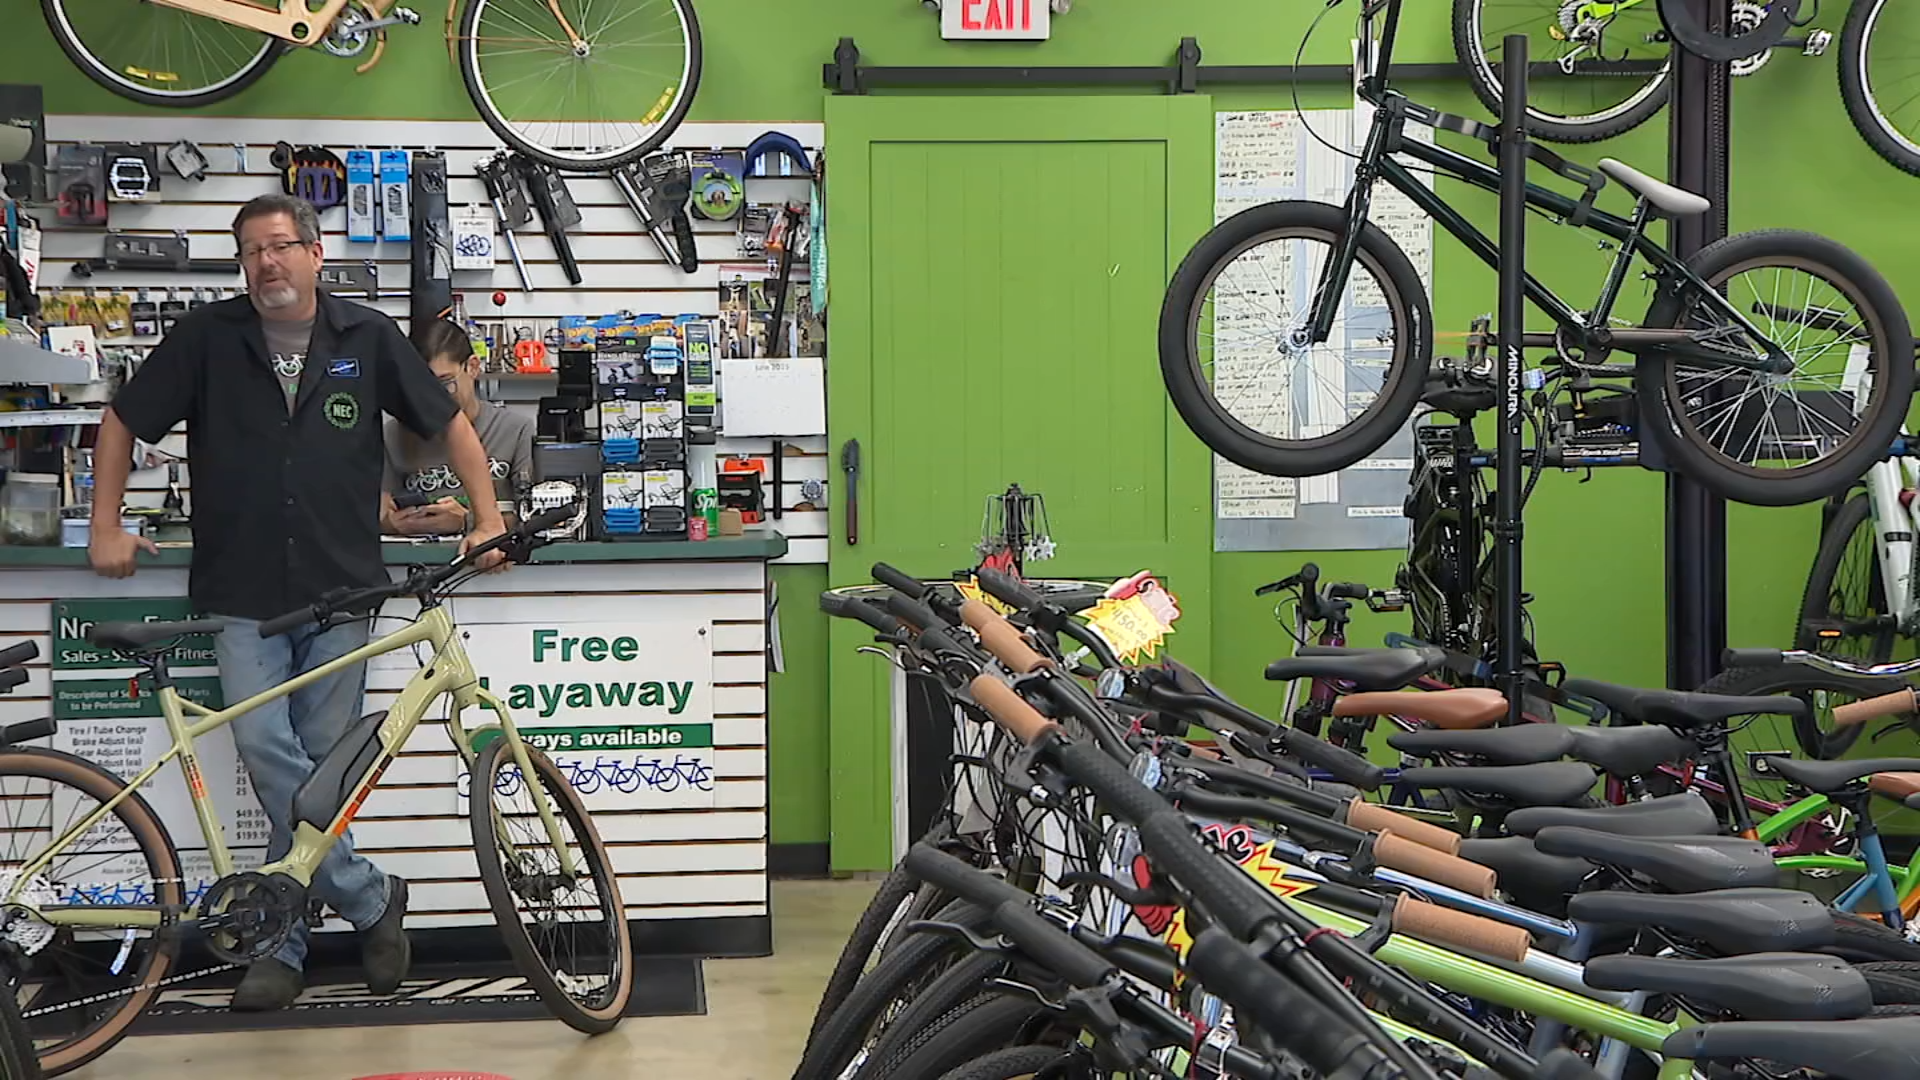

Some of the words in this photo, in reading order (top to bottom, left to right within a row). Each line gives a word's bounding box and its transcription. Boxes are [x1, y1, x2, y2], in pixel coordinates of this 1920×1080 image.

[688, 342, 709, 354] NO
[1507, 344, 1519, 419] MINOURA
[532, 629, 640, 662] Free
[61, 650, 99, 663] Sales
[175, 648, 216, 660] Fitnes
[58, 690, 108, 700] Description
[110, 689, 119, 698] of
[478, 676, 693, 718] Layaway
[70, 702, 79, 710] to
[81, 701, 92, 710] be
[94, 700, 141, 710] Performed
[68, 727, 85, 735] Tire
[93, 726, 113, 734] Tube
[115, 725, 147, 735] Change
[72, 737, 97, 746] Brake
[98, 737, 125, 745] Adjust
[579, 729, 682, 746] available
[97, 748, 123, 757] Adjust
[235, 776, 247, 785] 25
[235, 787, 247, 796] 25
